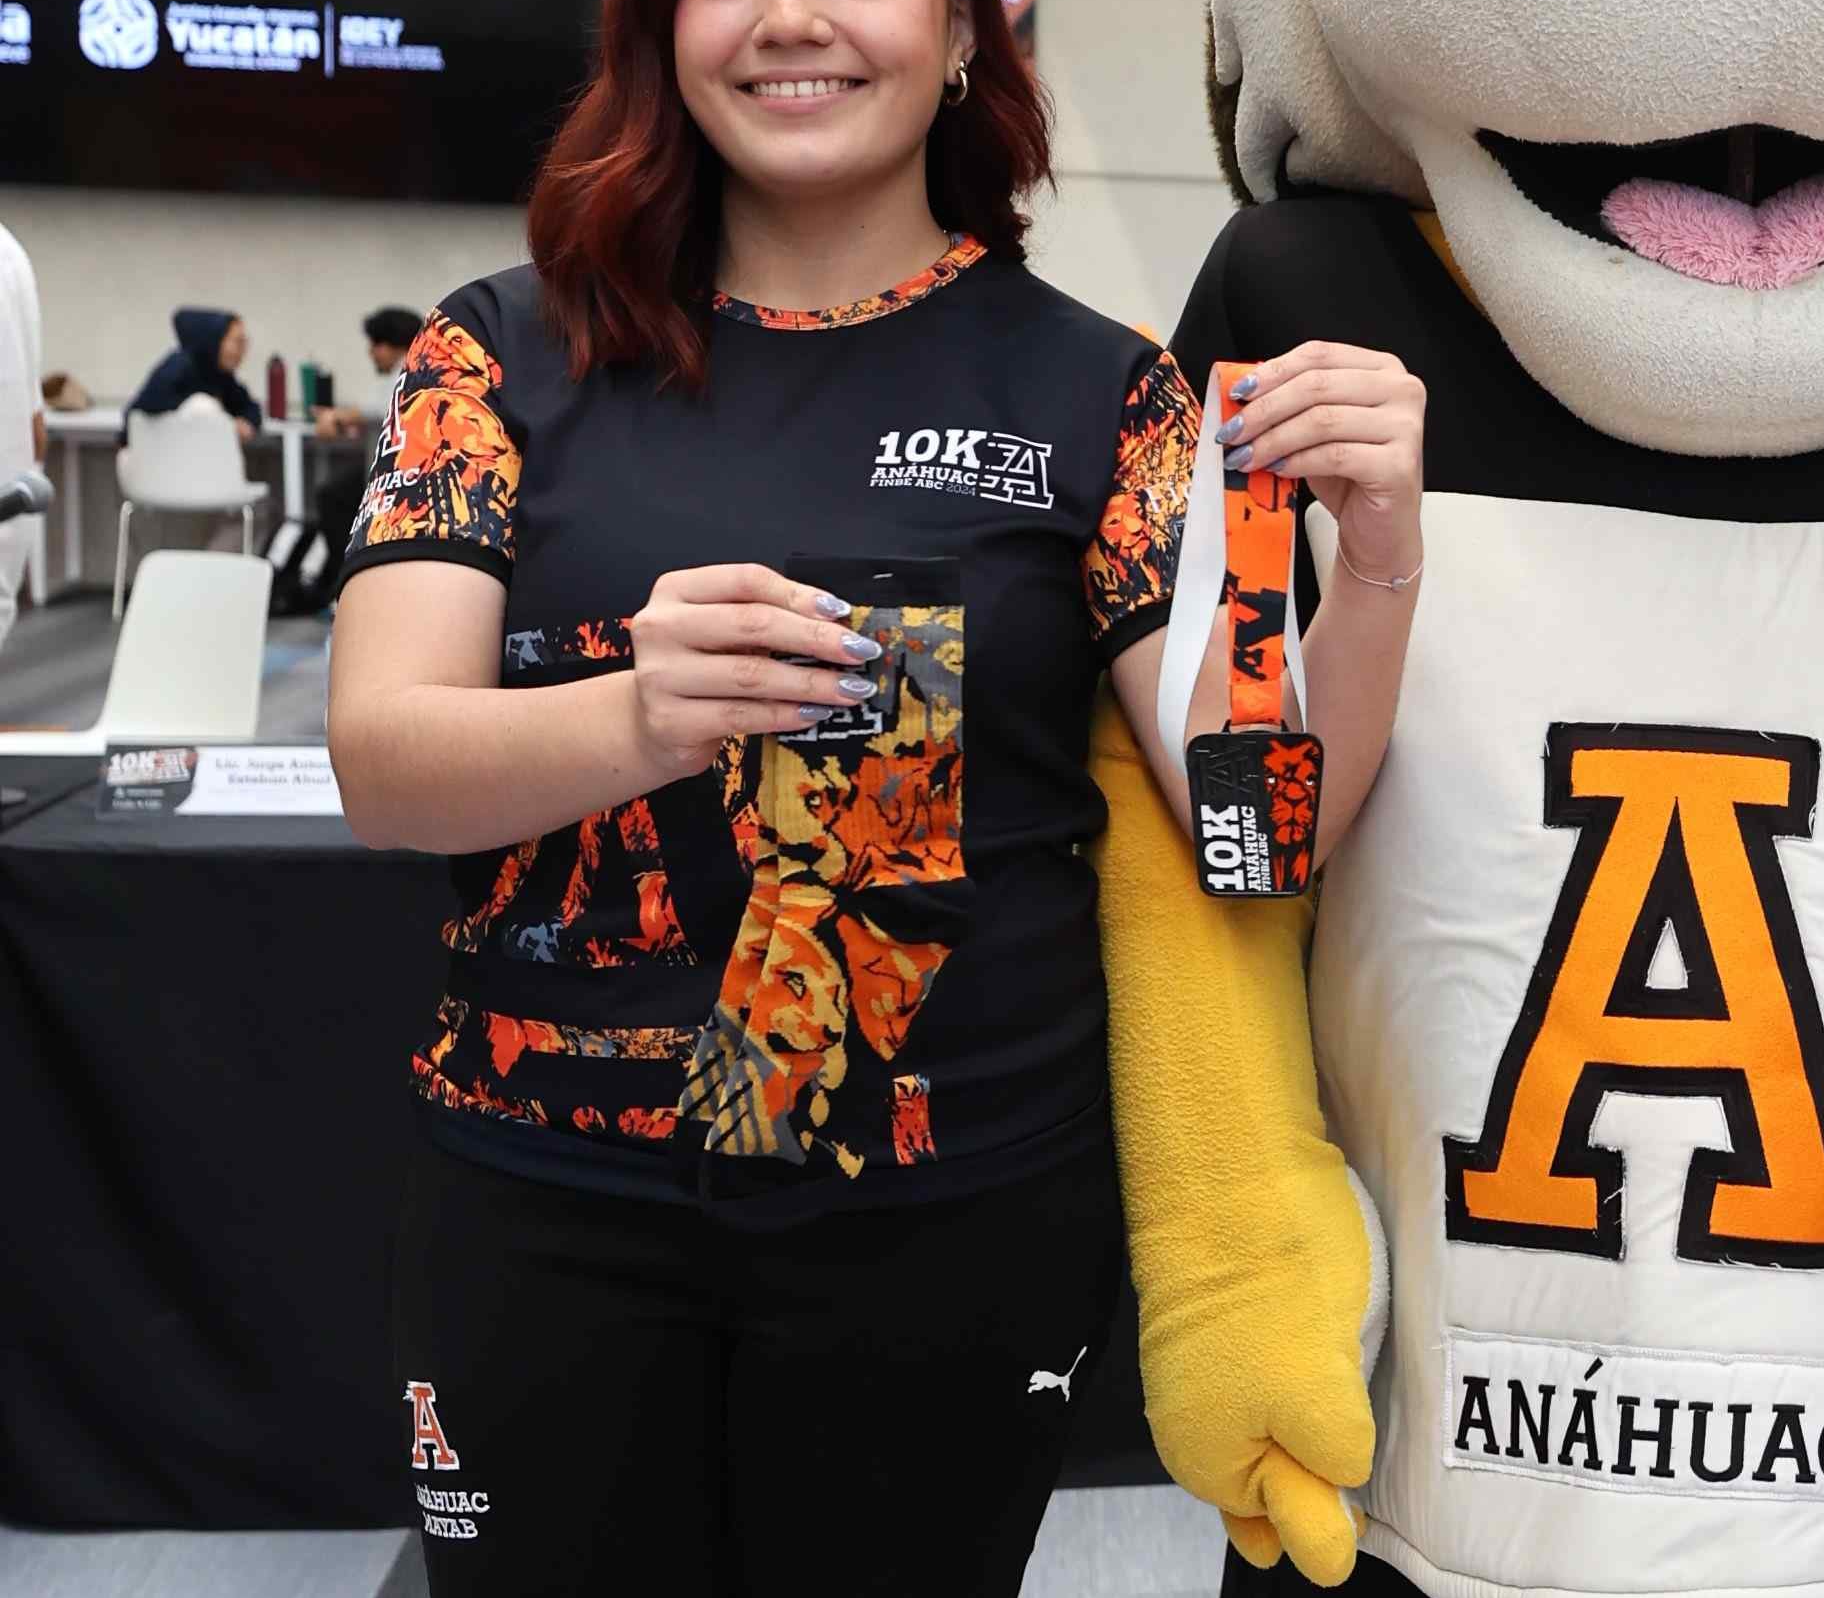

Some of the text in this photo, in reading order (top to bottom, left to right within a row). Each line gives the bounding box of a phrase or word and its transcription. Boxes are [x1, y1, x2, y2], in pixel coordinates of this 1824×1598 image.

[871, 463, 979, 486] ANÁHUAC
[874, 428, 988, 469] 10K
[869, 477, 976, 497] FINBE ABC 2024
[1200, 804, 1246, 891] 10K
[1240, 805, 1262, 892] ANÁHUAC
[402, 1380, 460, 1470] A
